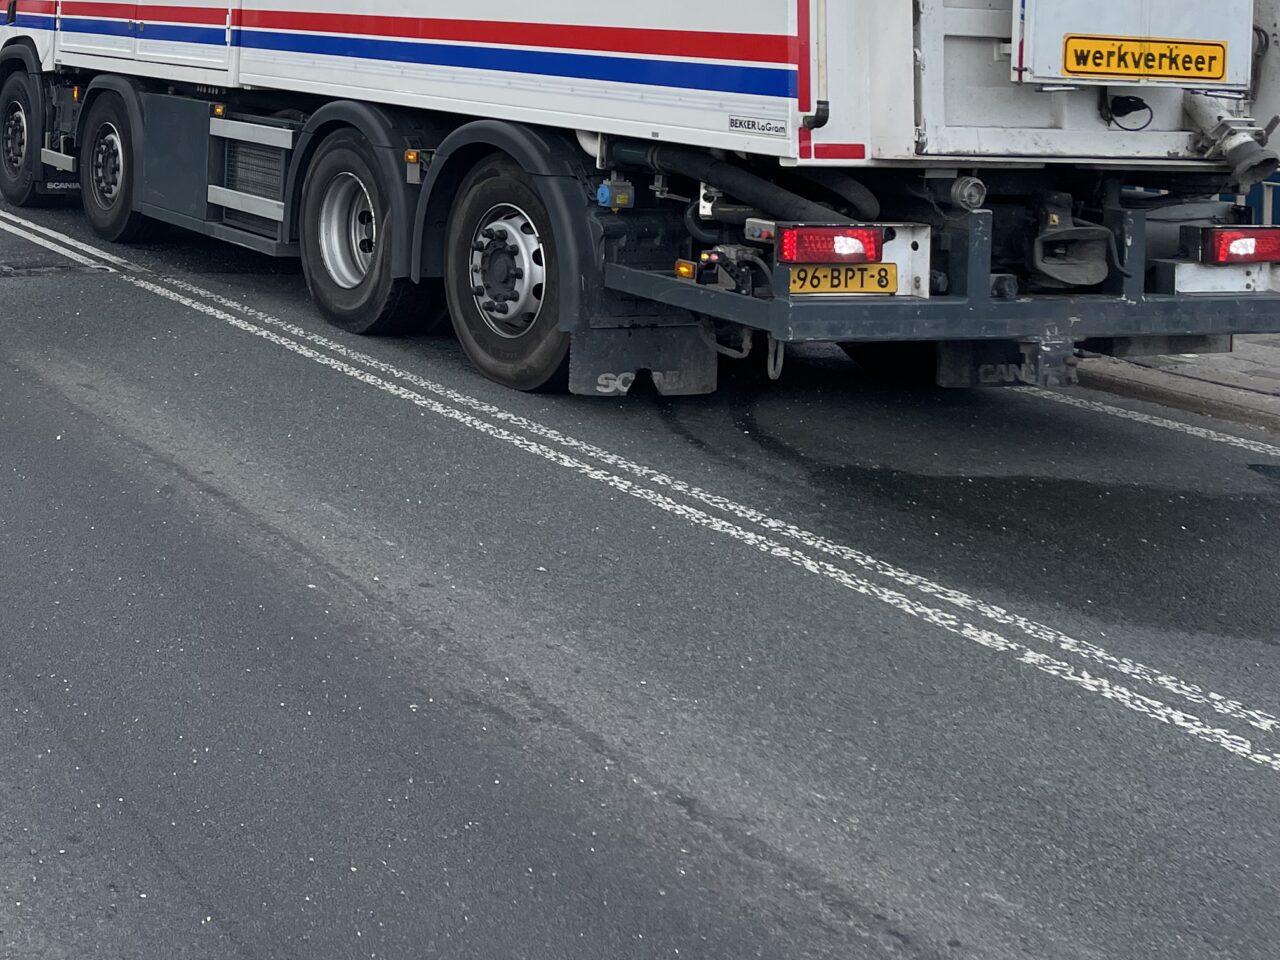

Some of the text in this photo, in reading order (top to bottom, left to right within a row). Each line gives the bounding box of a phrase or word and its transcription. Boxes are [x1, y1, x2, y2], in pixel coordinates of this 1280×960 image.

[1074, 44, 1217, 73] werkverkeer
[730, 118, 756, 131] BEKKER
[797, 267, 889, 289] 96-BPT-8
